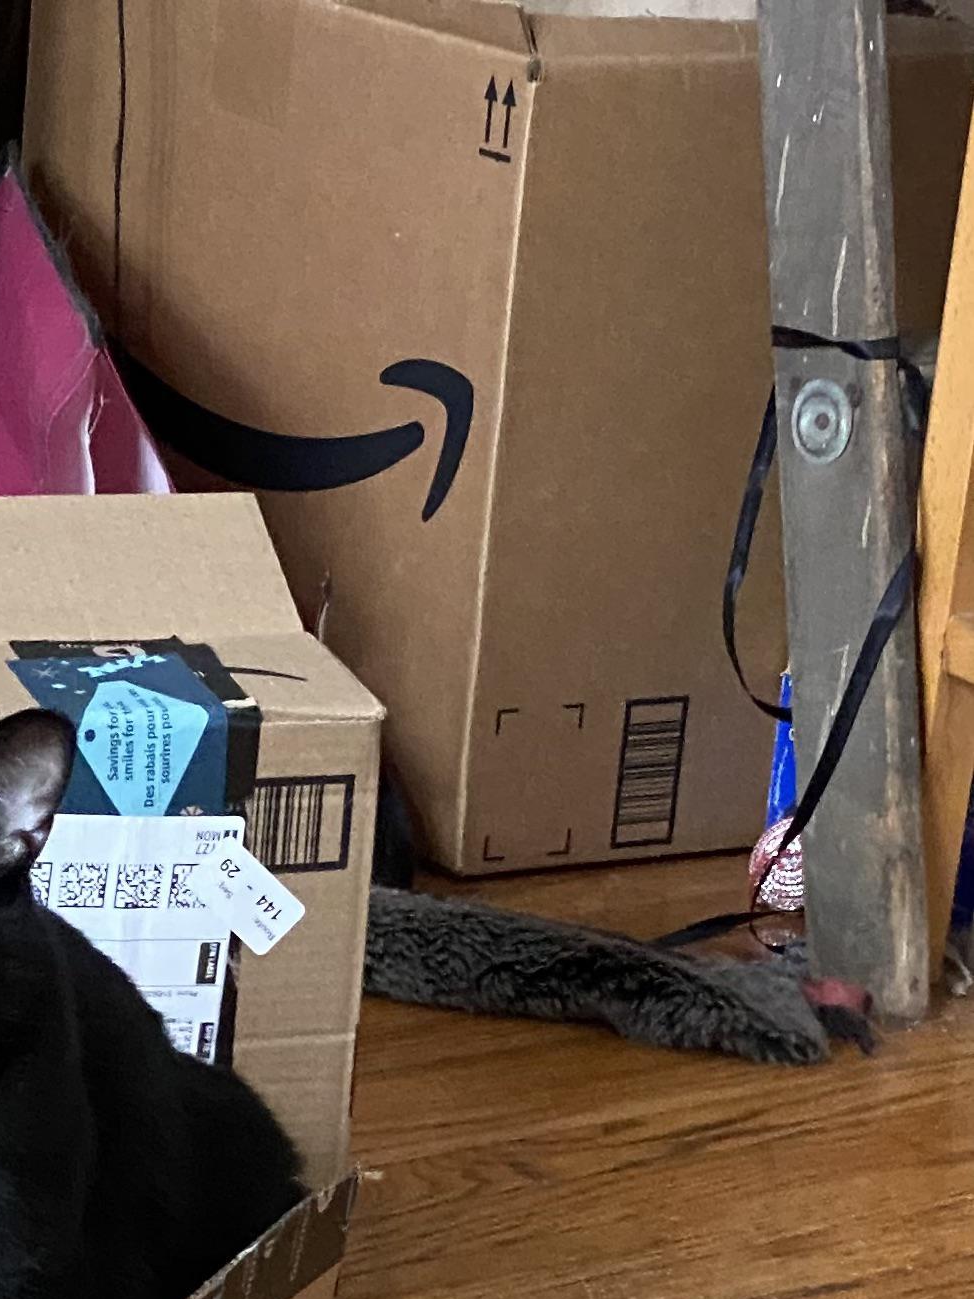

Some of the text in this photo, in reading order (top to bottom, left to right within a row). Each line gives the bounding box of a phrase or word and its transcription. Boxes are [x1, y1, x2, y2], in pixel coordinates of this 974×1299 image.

[107, 711, 119, 730] for
[121, 720, 134, 738] for
[107, 732, 122, 781] Savings
[122, 740, 134, 782] smiles
[143, 710, 158, 808] Des rabais pour
[160, 733, 171, 784] sourires
[195, 830, 222, 841] MON
[220, 858, 241, 878] 29
[256, 895, 282, 920] 144
